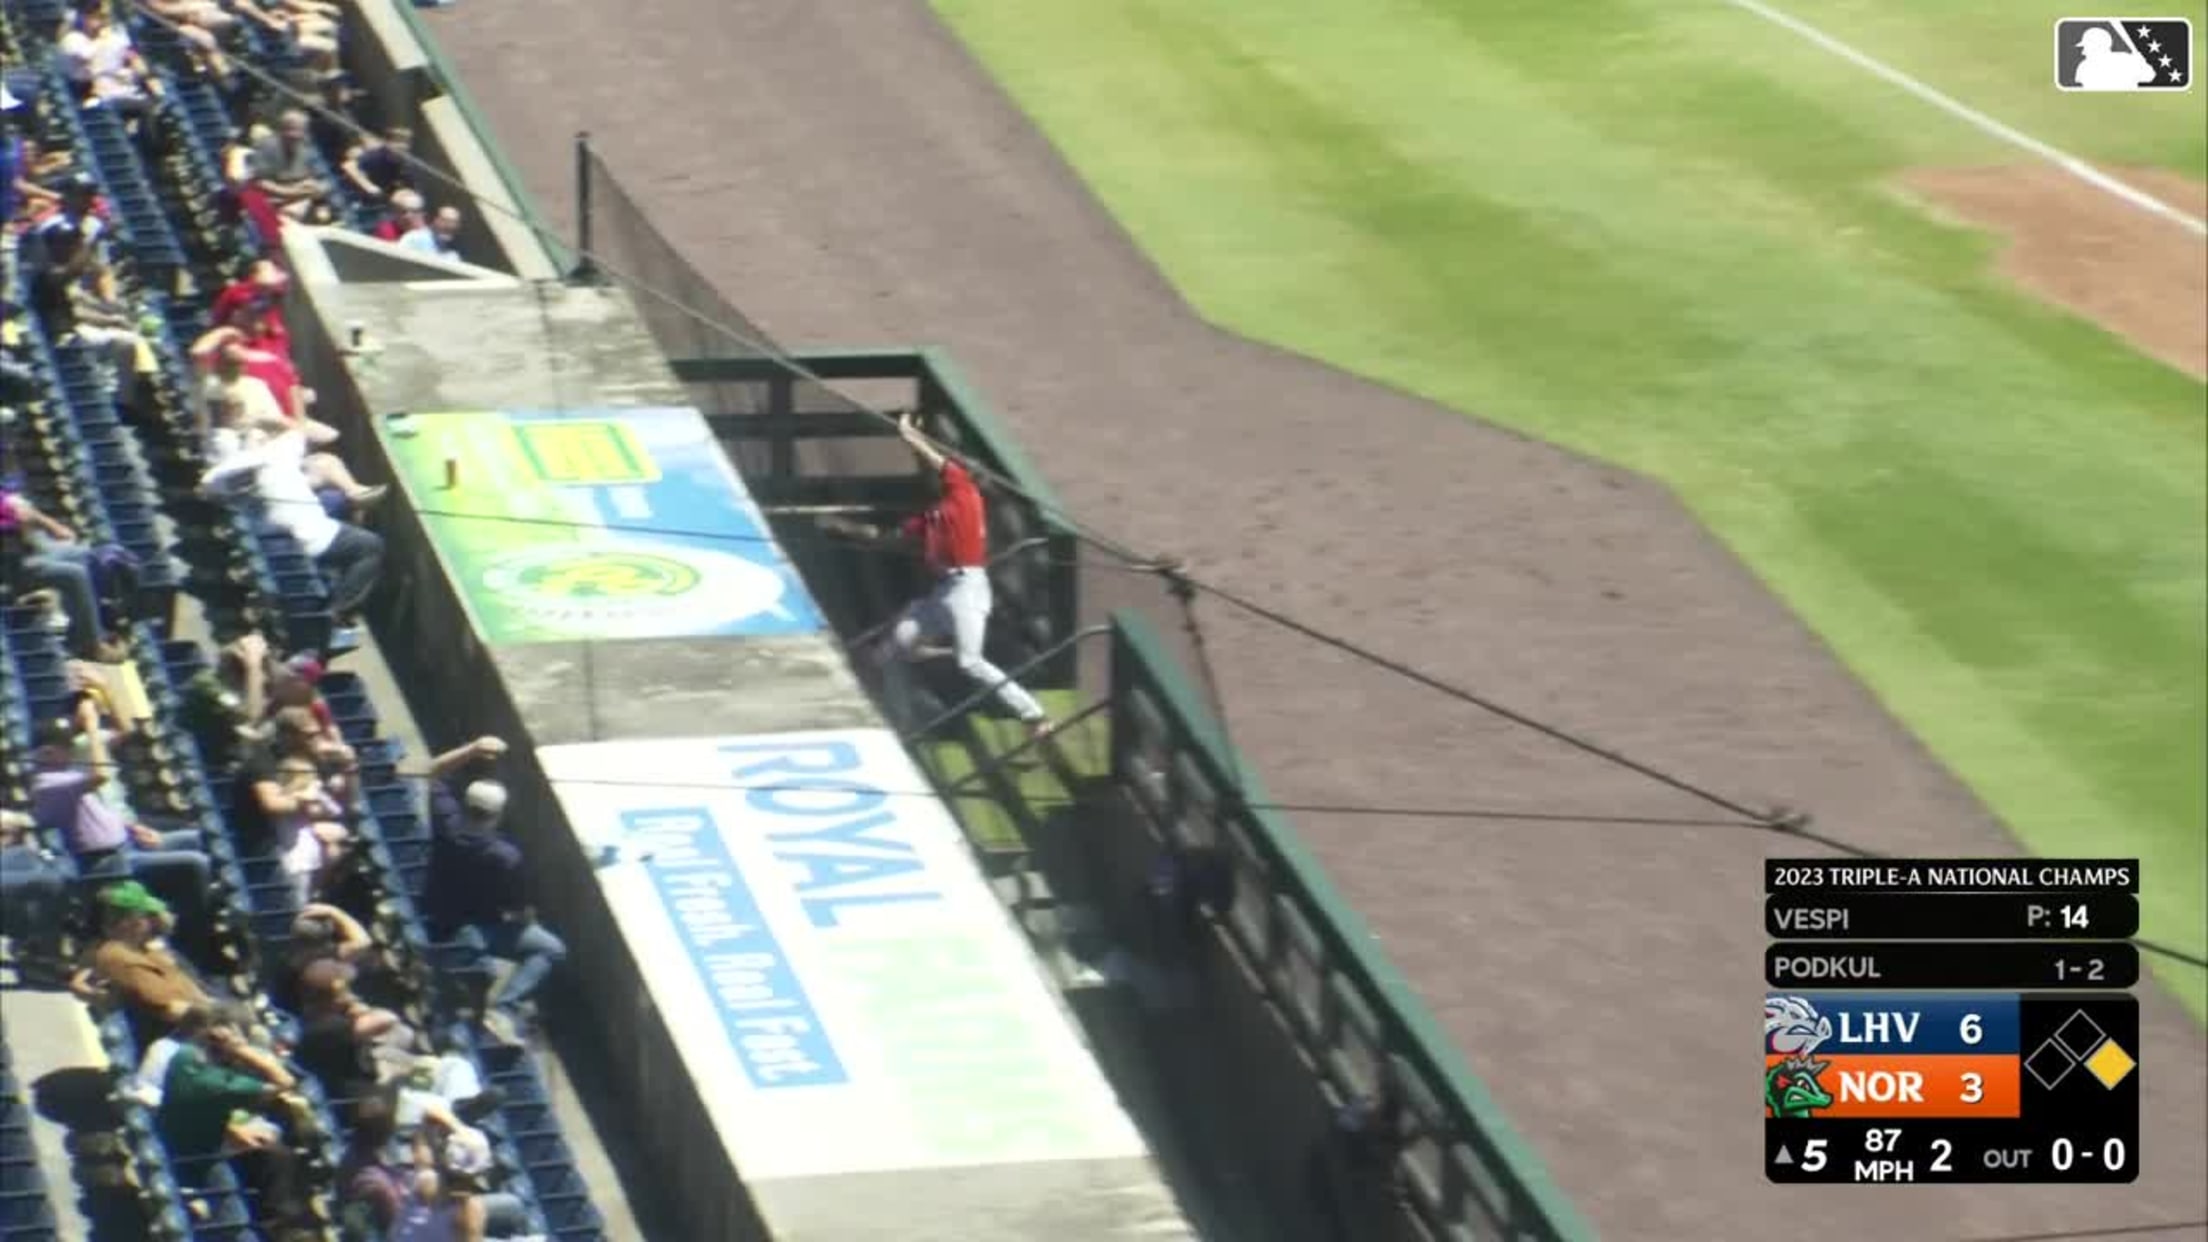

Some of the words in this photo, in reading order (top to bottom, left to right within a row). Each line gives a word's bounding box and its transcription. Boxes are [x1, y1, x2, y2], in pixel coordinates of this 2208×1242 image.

[633, 816, 720, 867] Real
[703, 952, 801, 1010] Real
[716, 740, 943, 929] ROYAL
